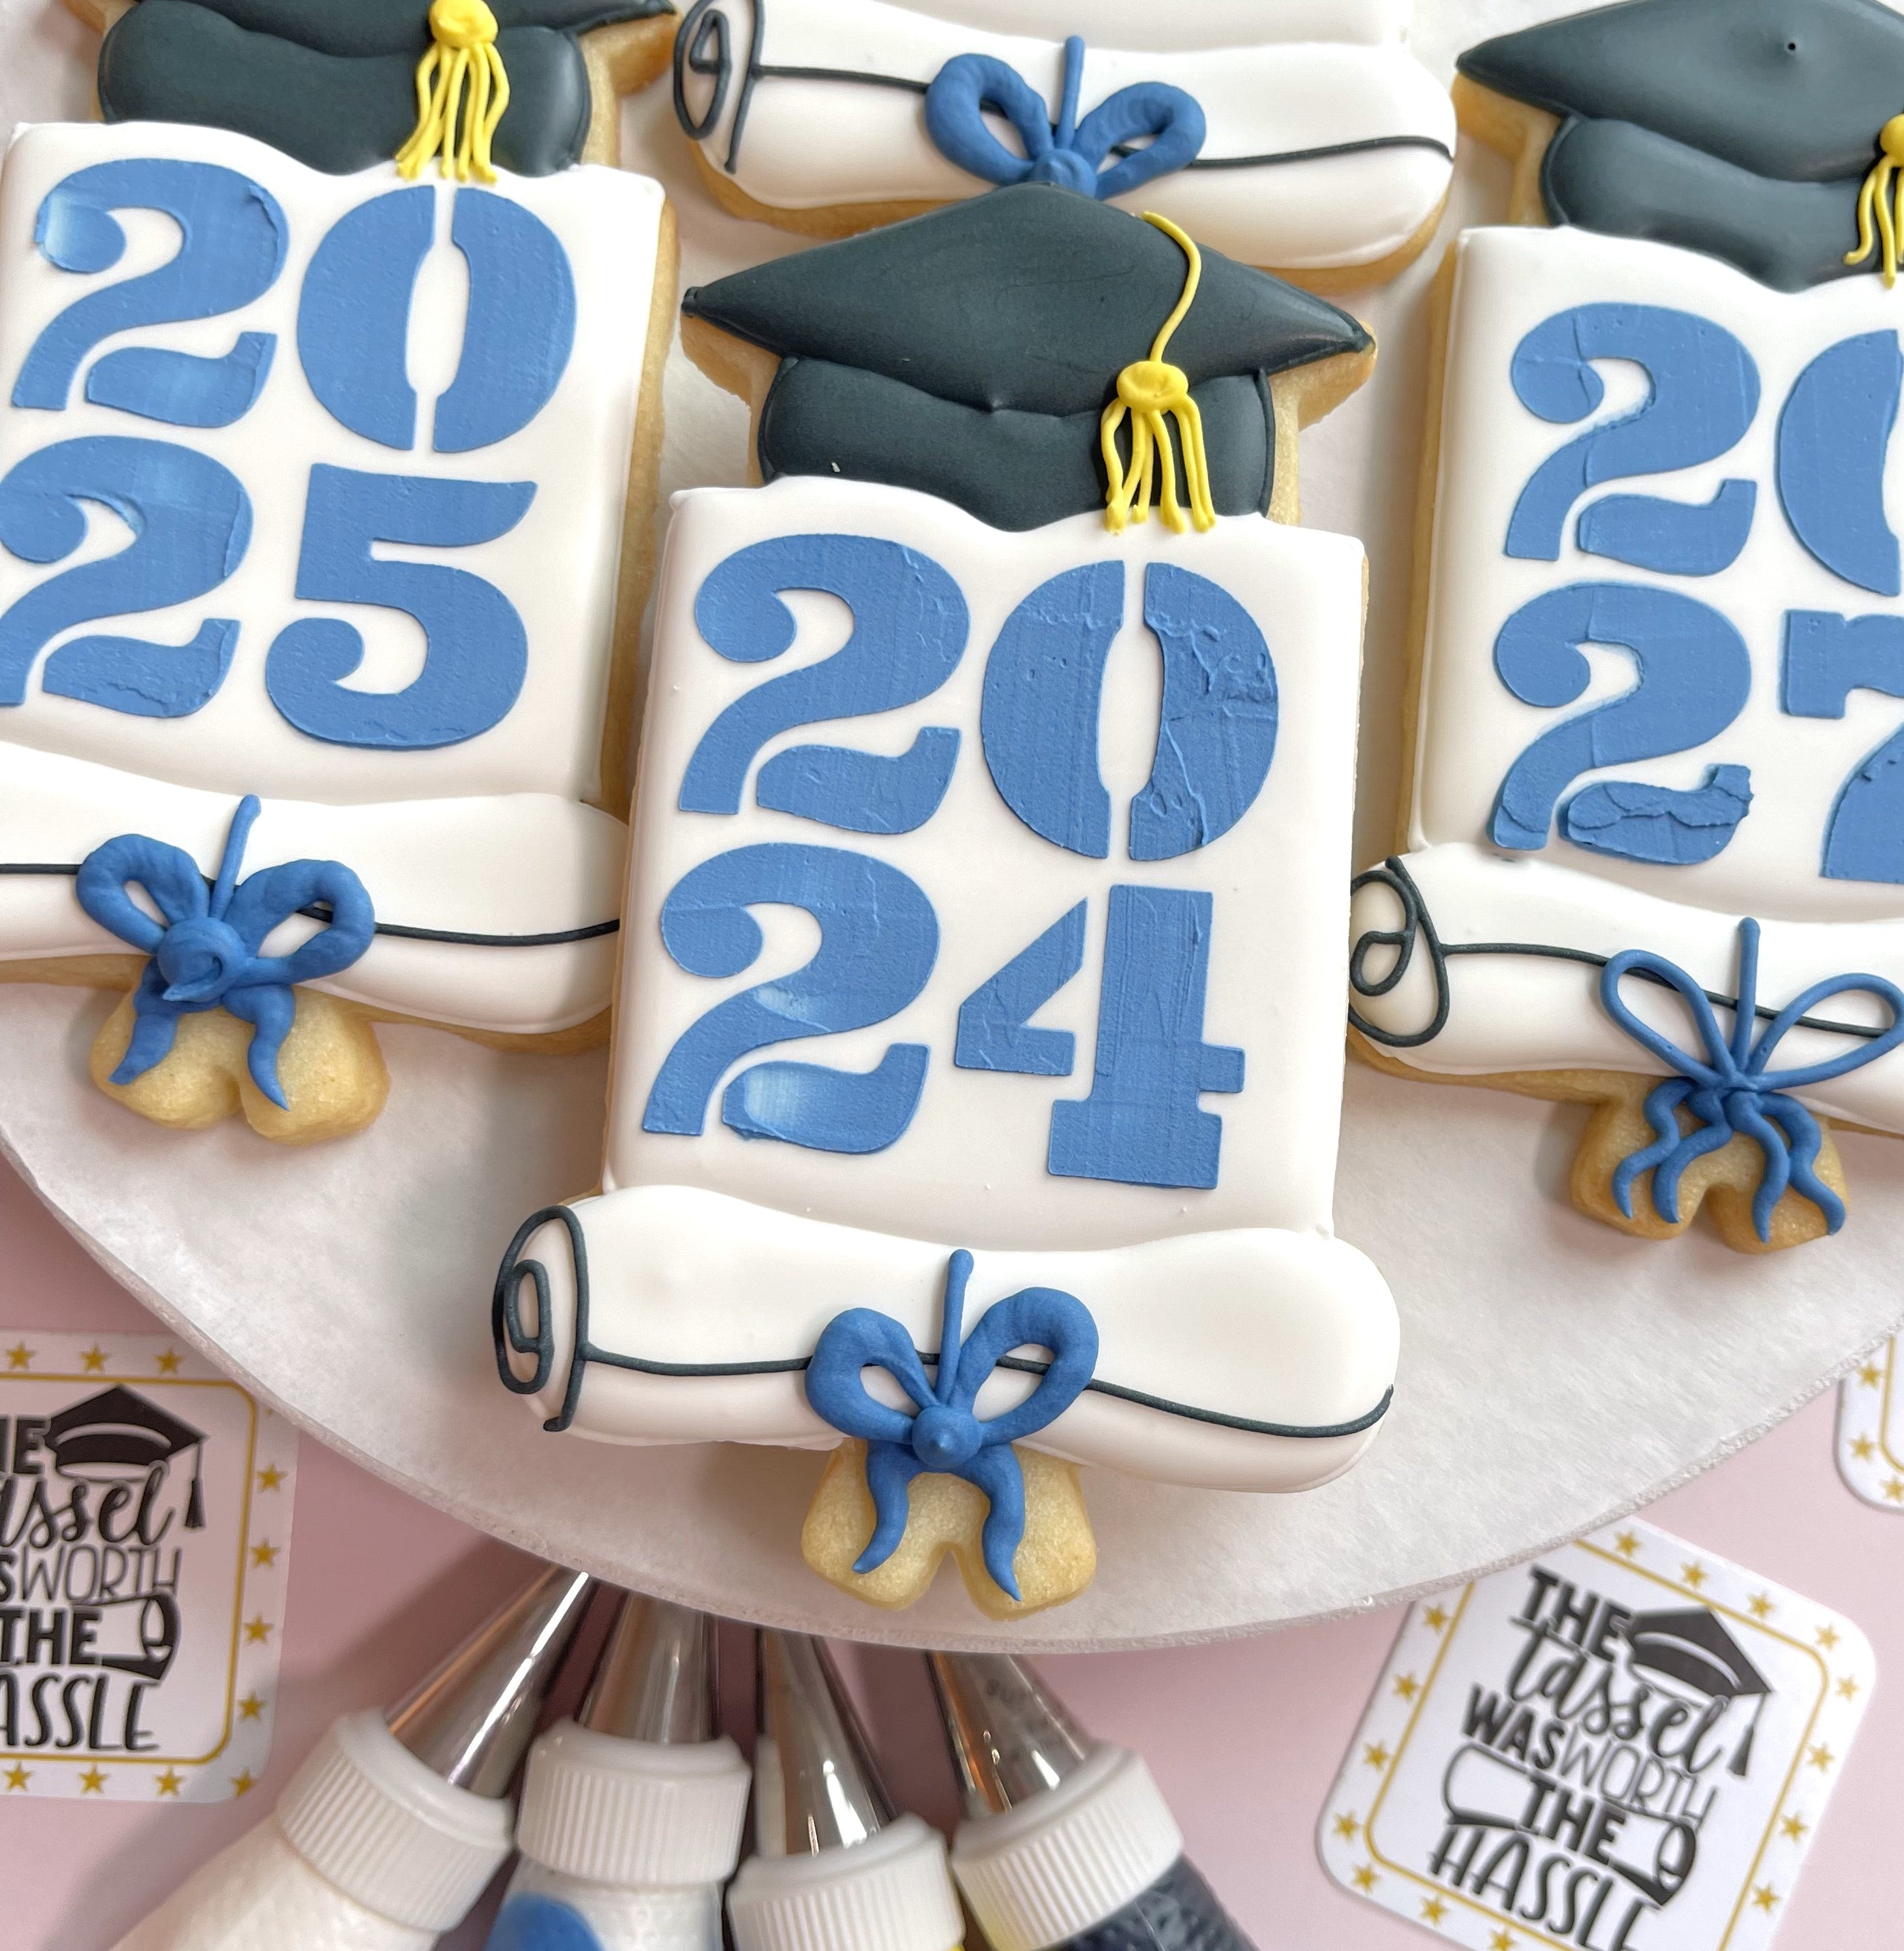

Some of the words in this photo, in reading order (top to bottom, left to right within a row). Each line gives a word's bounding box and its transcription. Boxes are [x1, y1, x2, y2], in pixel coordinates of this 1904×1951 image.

[12, 158, 577, 452] 20
[0, 435, 538, 750] 25
[677, 533, 1279, 861] 20
[642, 842, 1246, 1188] 24
[0, 1608, 102, 1665] THE
[1523, 1564, 1633, 1663] THE
[1463, 1682, 1566, 1770] WAS
[1509, 1614, 1723, 1776] tassel
[1521, 1775, 1627, 1864] THE
